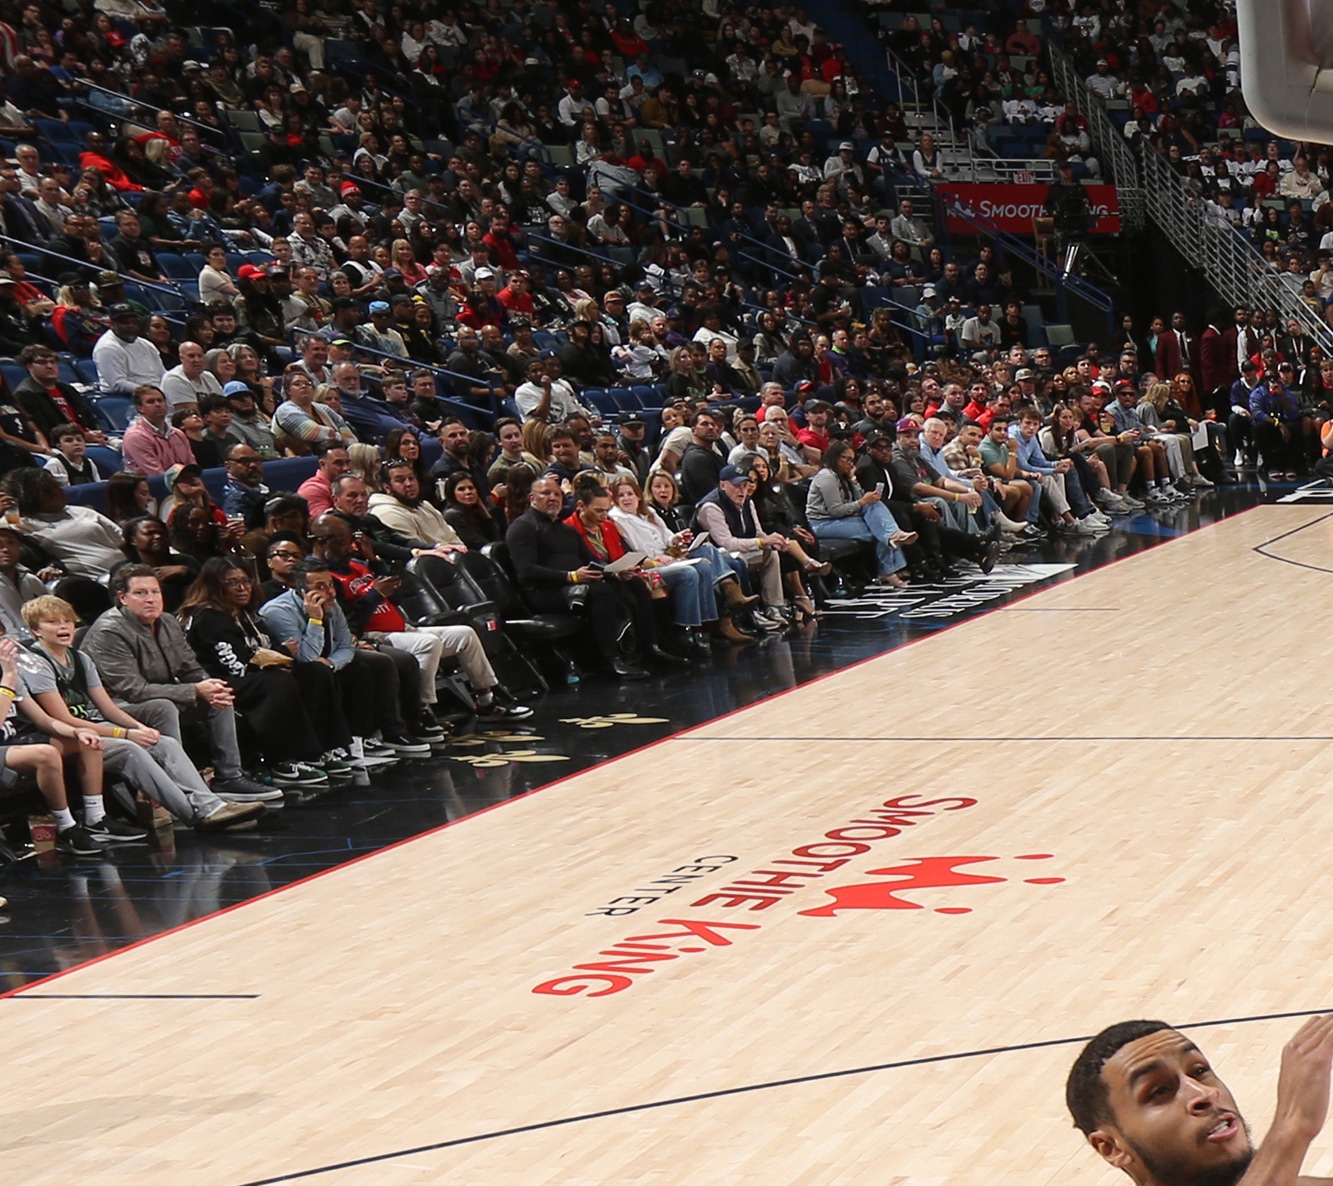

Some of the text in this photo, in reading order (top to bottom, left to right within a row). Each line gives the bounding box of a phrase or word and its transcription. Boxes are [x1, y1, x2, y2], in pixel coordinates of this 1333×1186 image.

[979, 200, 1048, 218] SMOOTH
[585, 855, 738, 917] CENTER
[689, 795, 978, 912] SMOOTHIE
[531, 918, 762, 997] KING
